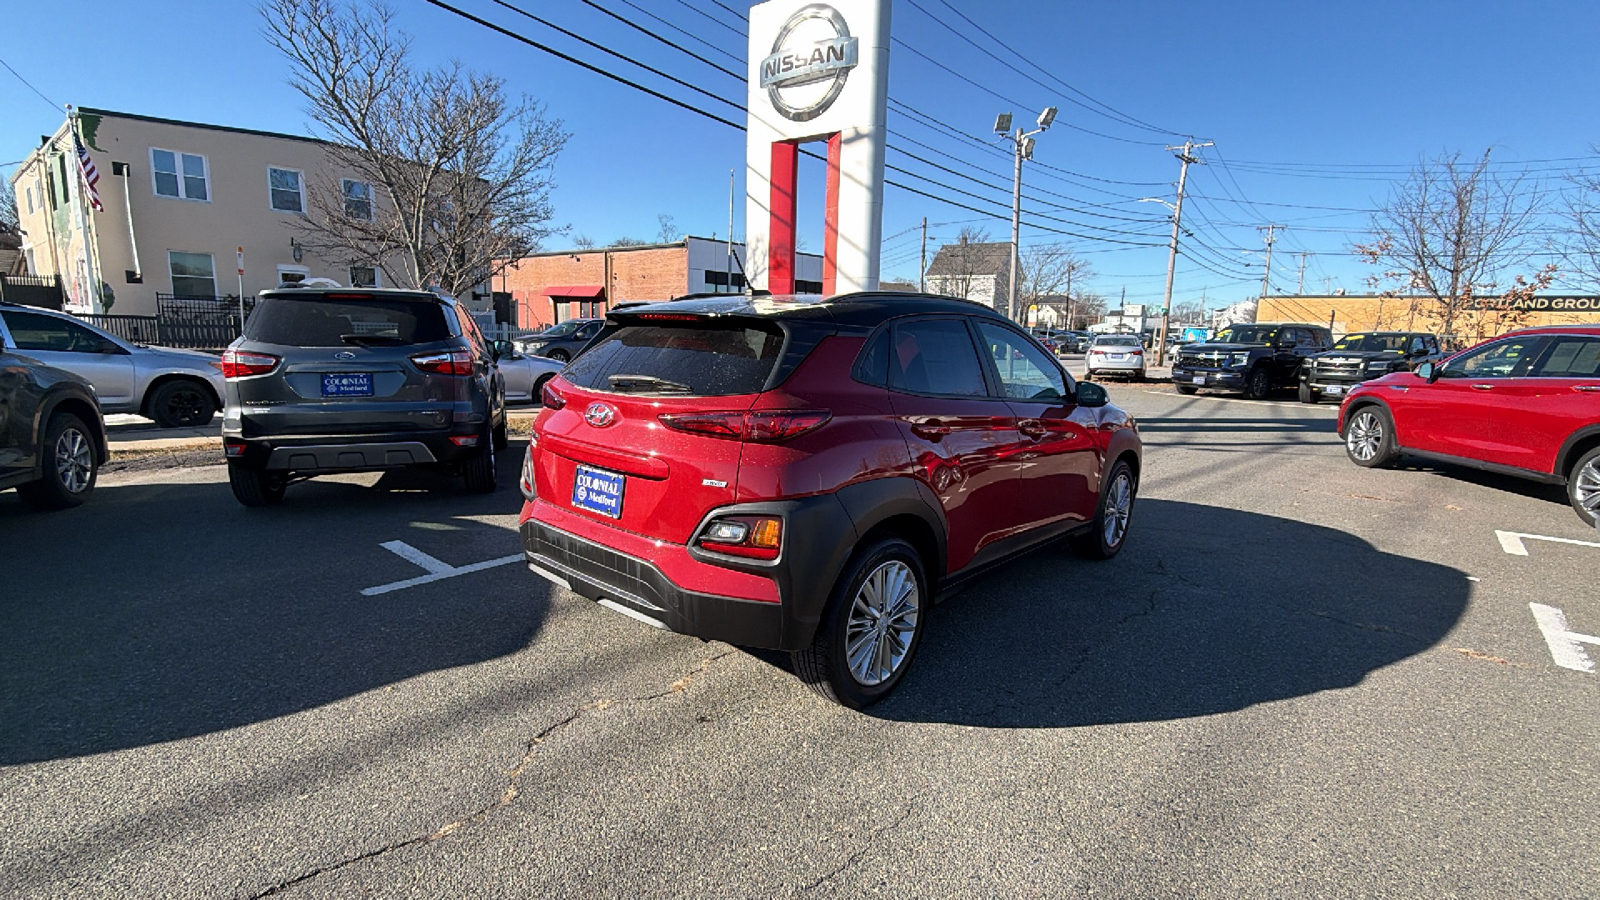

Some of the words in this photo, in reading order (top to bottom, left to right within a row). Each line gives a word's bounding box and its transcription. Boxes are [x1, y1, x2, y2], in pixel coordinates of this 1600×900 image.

[765, 43, 844, 78] NISSAN
[577, 474, 620, 495] COLONIAL
[587, 491, 616, 507] Medford
